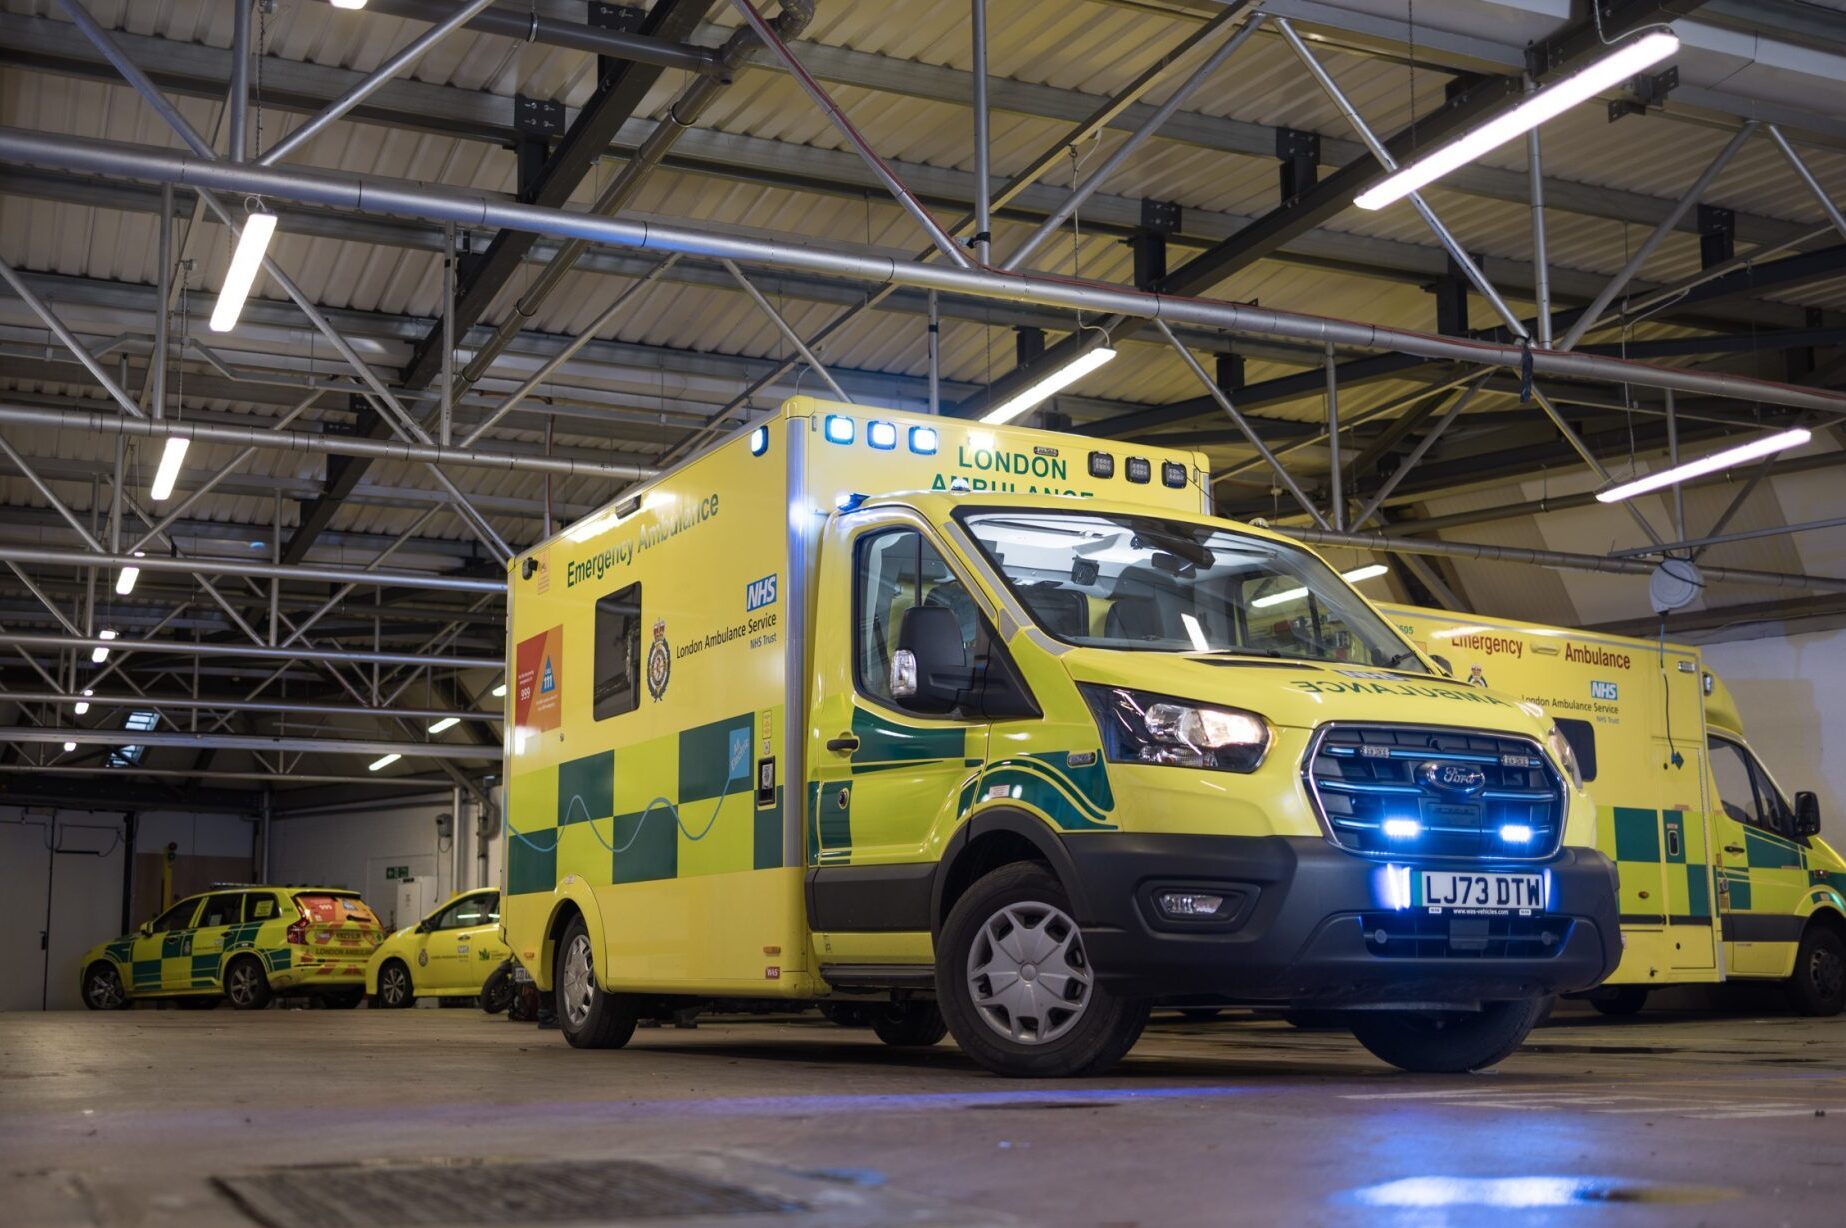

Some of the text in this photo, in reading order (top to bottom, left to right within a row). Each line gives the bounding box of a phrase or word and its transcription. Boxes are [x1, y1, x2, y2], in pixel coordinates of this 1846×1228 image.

[958, 446, 1068, 481] LONDON
[567, 540, 635, 588] Emergency
[637, 493, 720, 553] Ambulance
[747, 575, 776, 611] NHS
[676, 612, 777, 659] London Ambulance Service
[750, 633, 777, 649] NHS Trust
[1565, 643, 1631, 670] Ambulance
[543, 675, 553, 689] 111
[1592, 683, 1617, 699] NHS
[520, 686, 531, 701] 999
[1552, 698, 1592, 712] Ambulance
[1594, 703, 1619, 715] Service
[1443, 766, 1476, 785] Ford
[1426, 876, 1540, 906] LJ73 DTW
[767, 968, 779, 976] WAS
